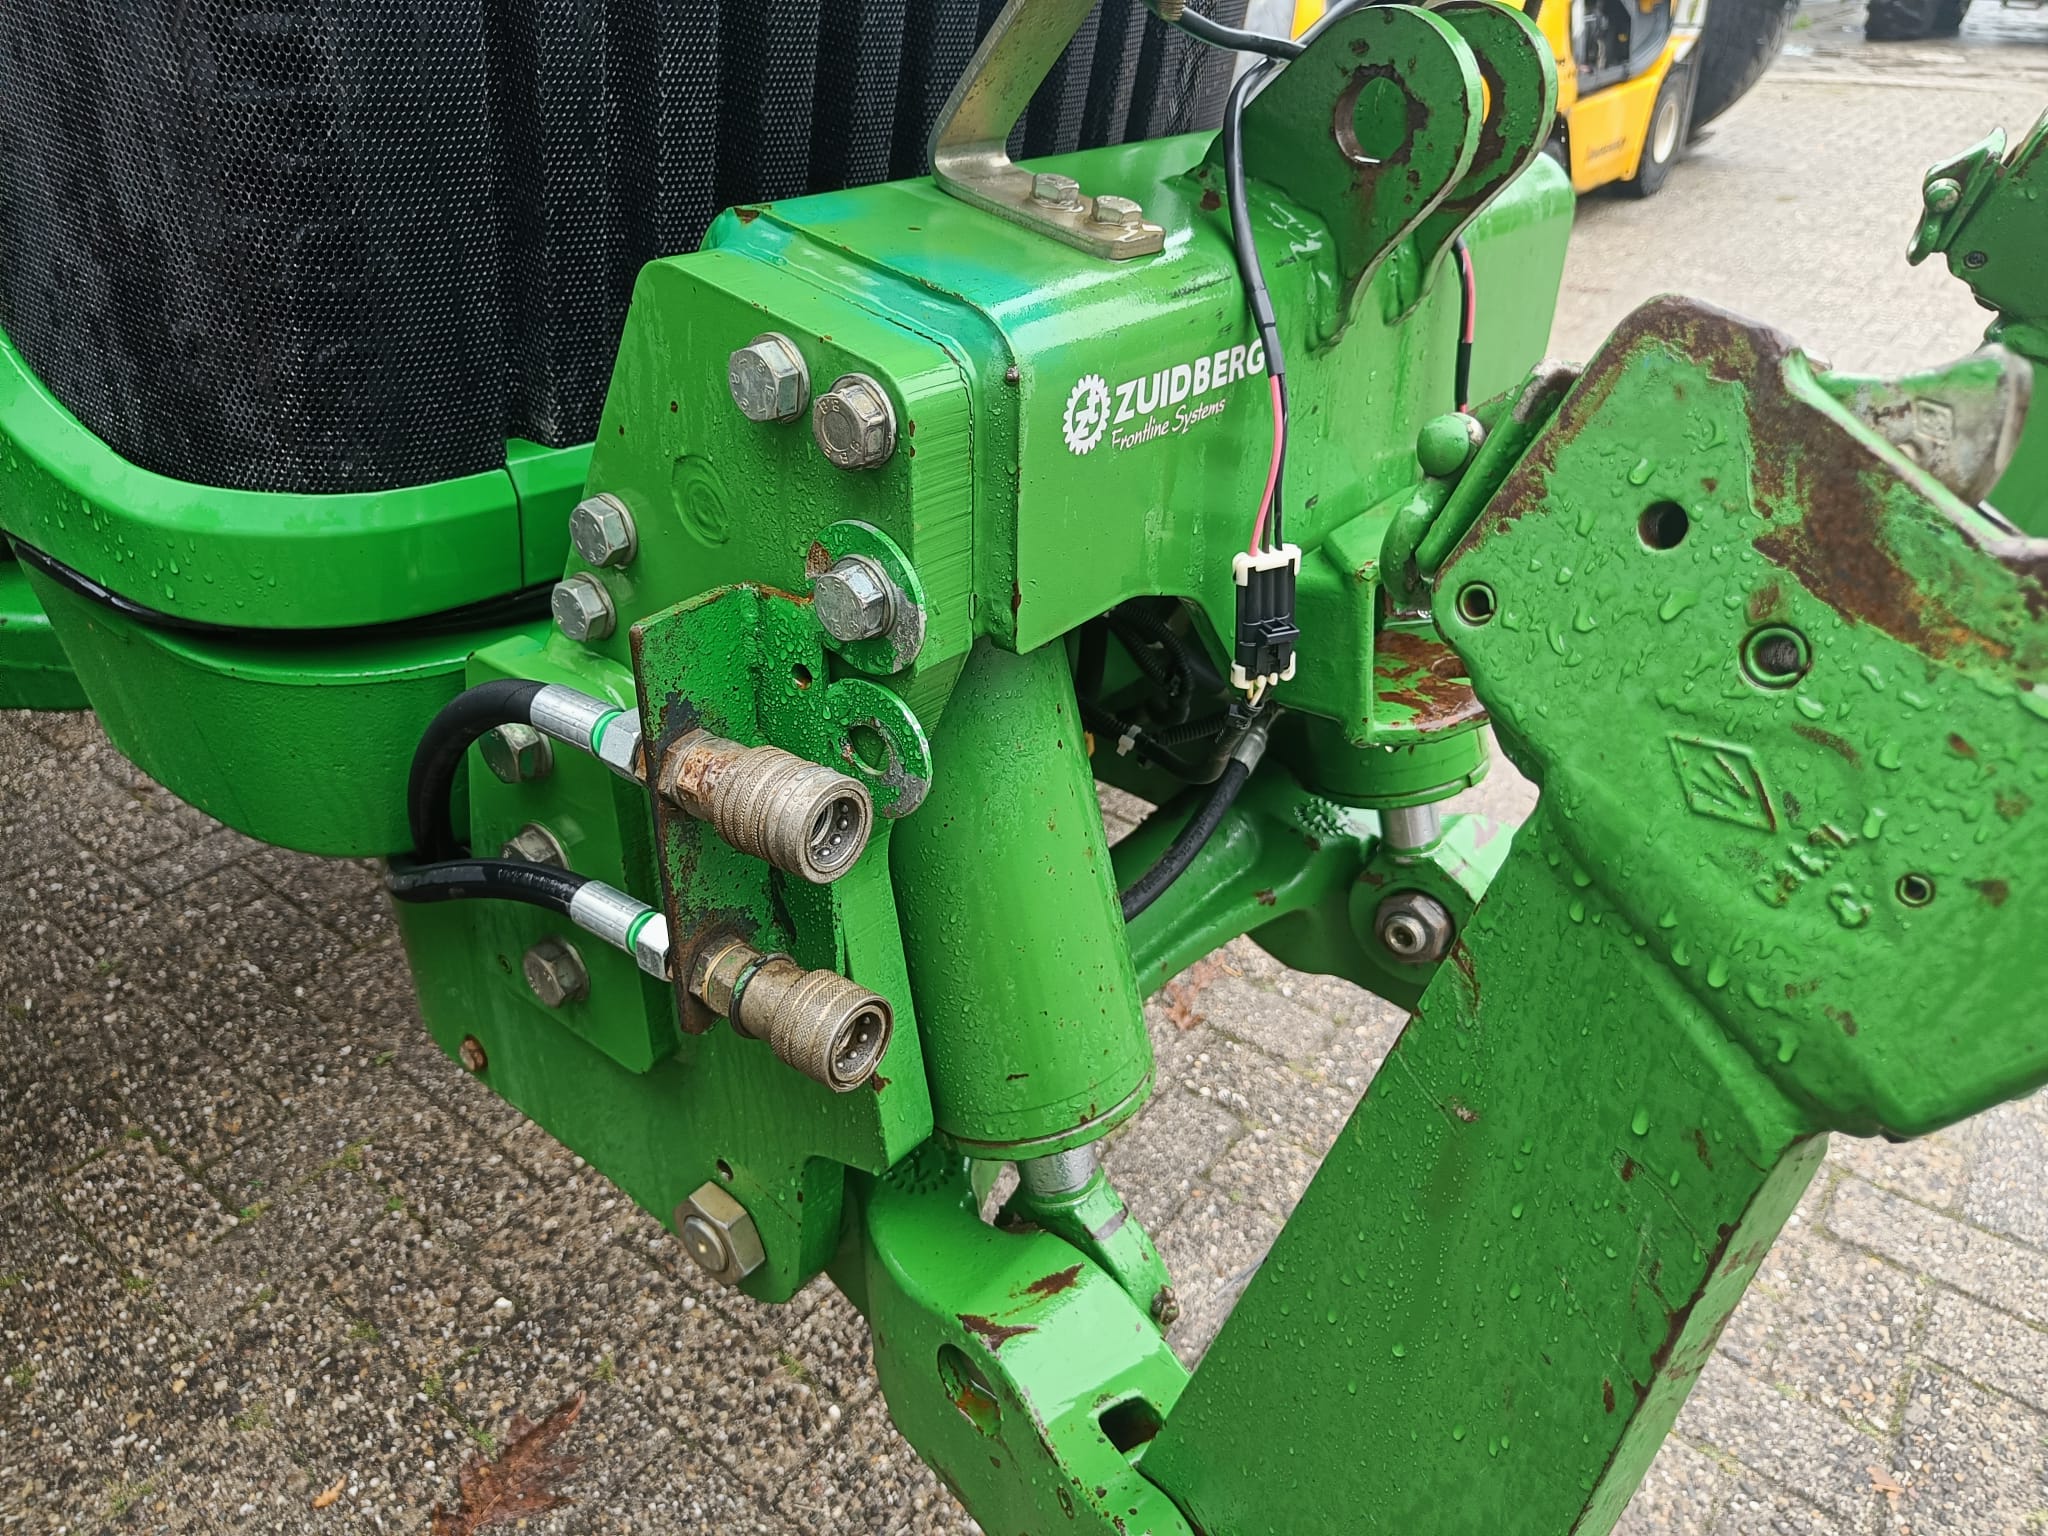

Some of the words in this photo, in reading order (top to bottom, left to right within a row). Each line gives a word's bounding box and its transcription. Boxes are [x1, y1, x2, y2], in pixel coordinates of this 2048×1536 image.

[1112, 337, 1265, 425] ZUIDBERG
[1111, 415, 1169, 451] Frontline
[1172, 398, 1226, 434] Systems
